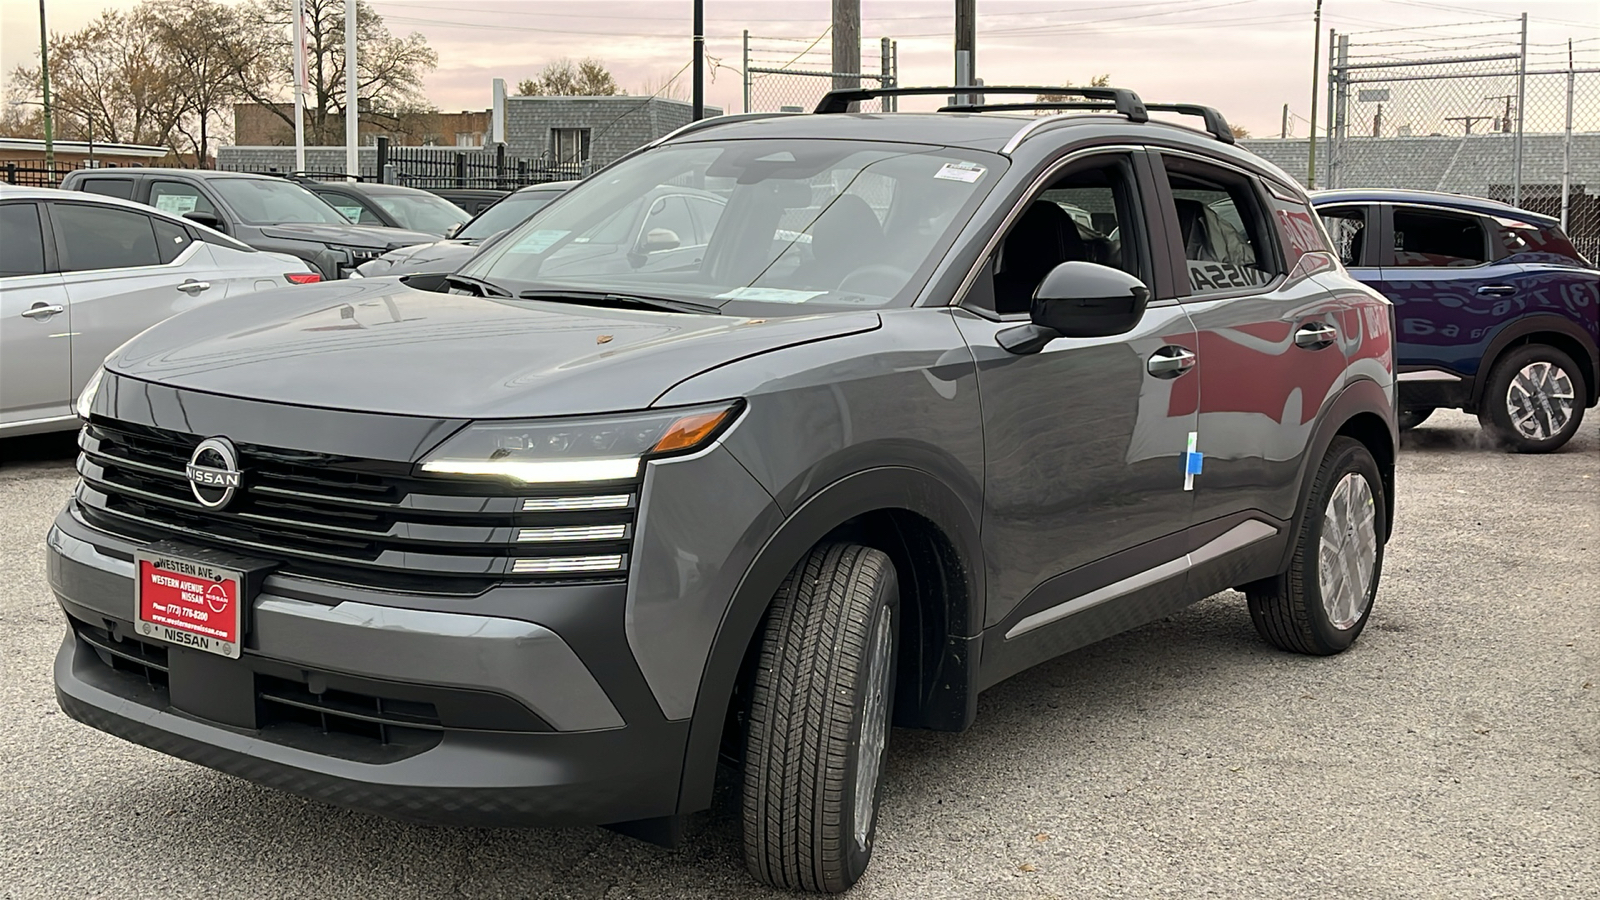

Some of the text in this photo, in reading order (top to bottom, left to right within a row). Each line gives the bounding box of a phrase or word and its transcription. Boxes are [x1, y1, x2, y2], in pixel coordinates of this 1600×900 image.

[186, 466, 238, 486] NISSAN
[158, 558, 214, 579] WESTERN AVE
[151, 574, 204, 594] WESTERN AVENUE
[181, 592, 204, 605] NISSAN
[206, 594, 228, 603] NISSAN
[167, 604, 182, 617] (773)
[182, 607, 209, 622] 776-8200
[164, 628, 209, 649] NISSAN
